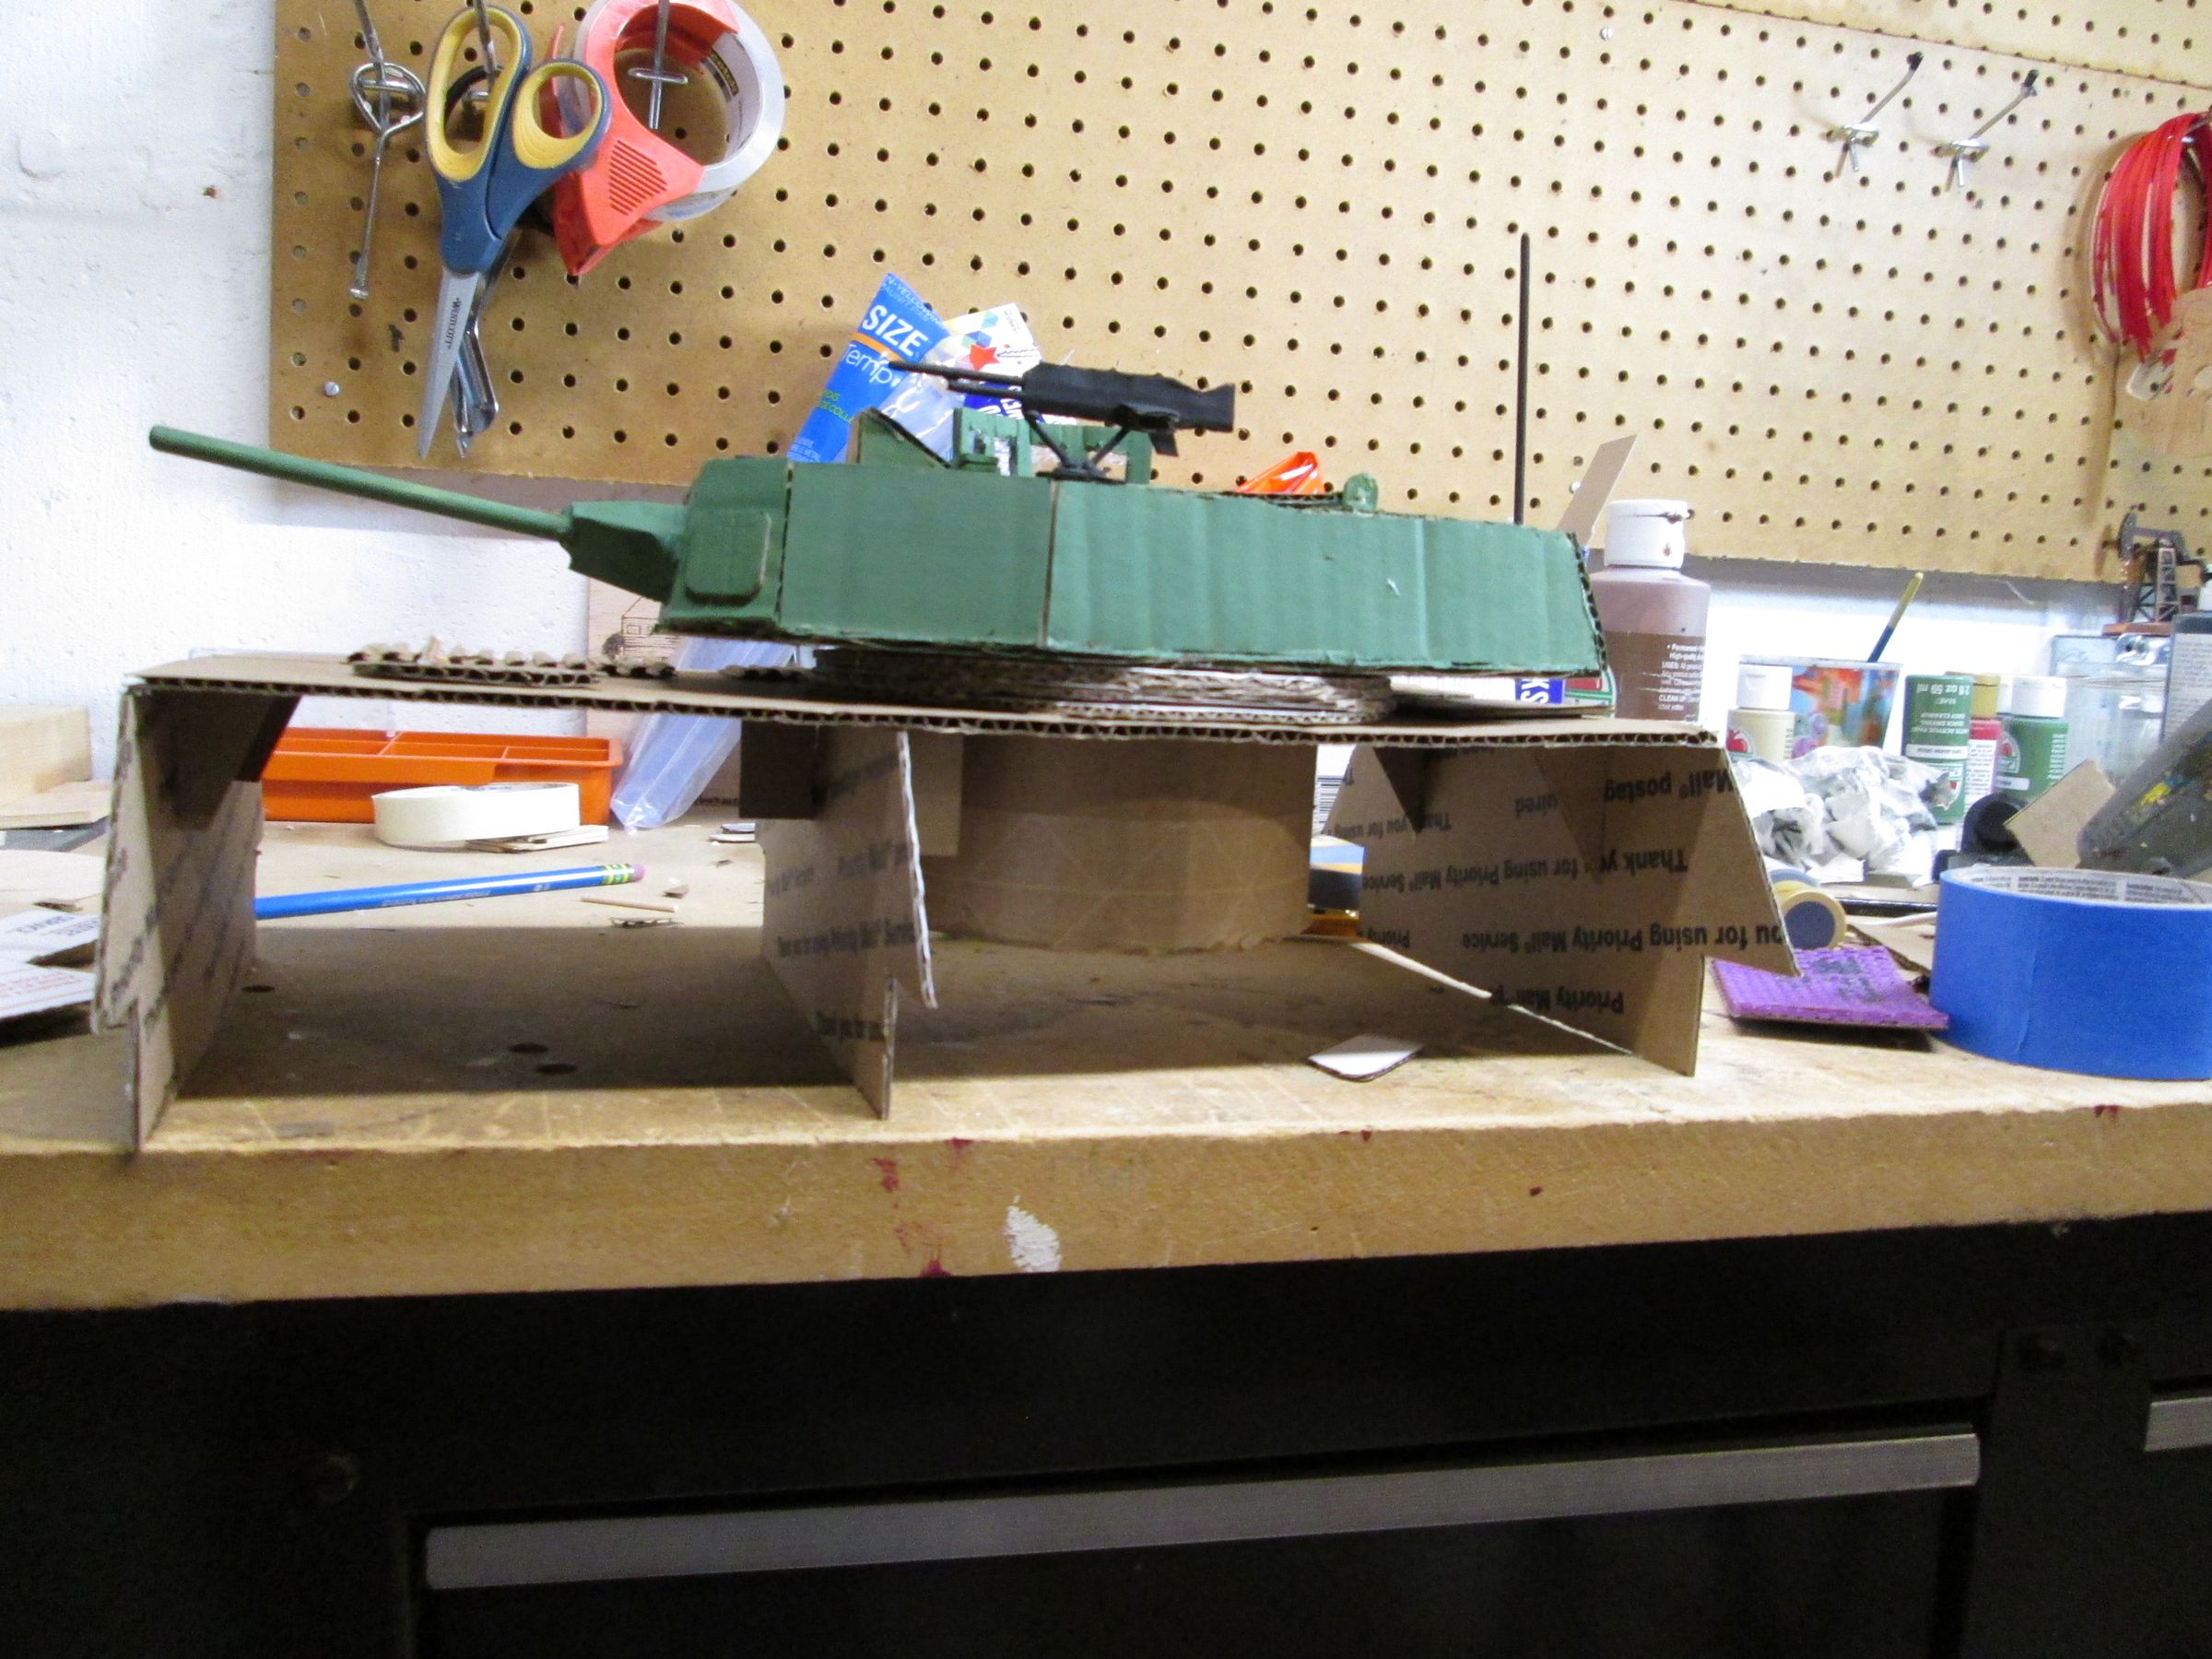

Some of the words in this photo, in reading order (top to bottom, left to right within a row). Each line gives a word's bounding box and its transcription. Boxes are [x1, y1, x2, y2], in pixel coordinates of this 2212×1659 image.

[862, 305, 929, 357] SIZE
[841, 343, 901, 388] Temp
[1604, 771, 1672, 803] postag
[1515, 793, 1559, 819] uired
[1445, 864, 1500, 886] Priority
[1503, 858, 1549, 883] using
[1554, 857, 1578, 880] for
[1623, 849, 1688, 875] Thank
[1362, 872, 1406, 893] Service
[1462, 931, 1519, 953] Service
[1571, 924, 1643, 952] Priority
[1649, 922, 1708, 951] using
[1714, 924, 1748, 950] for
[1756, 923, 1783, 946] ou
[1555, 985, 1624, 1014] Priority
